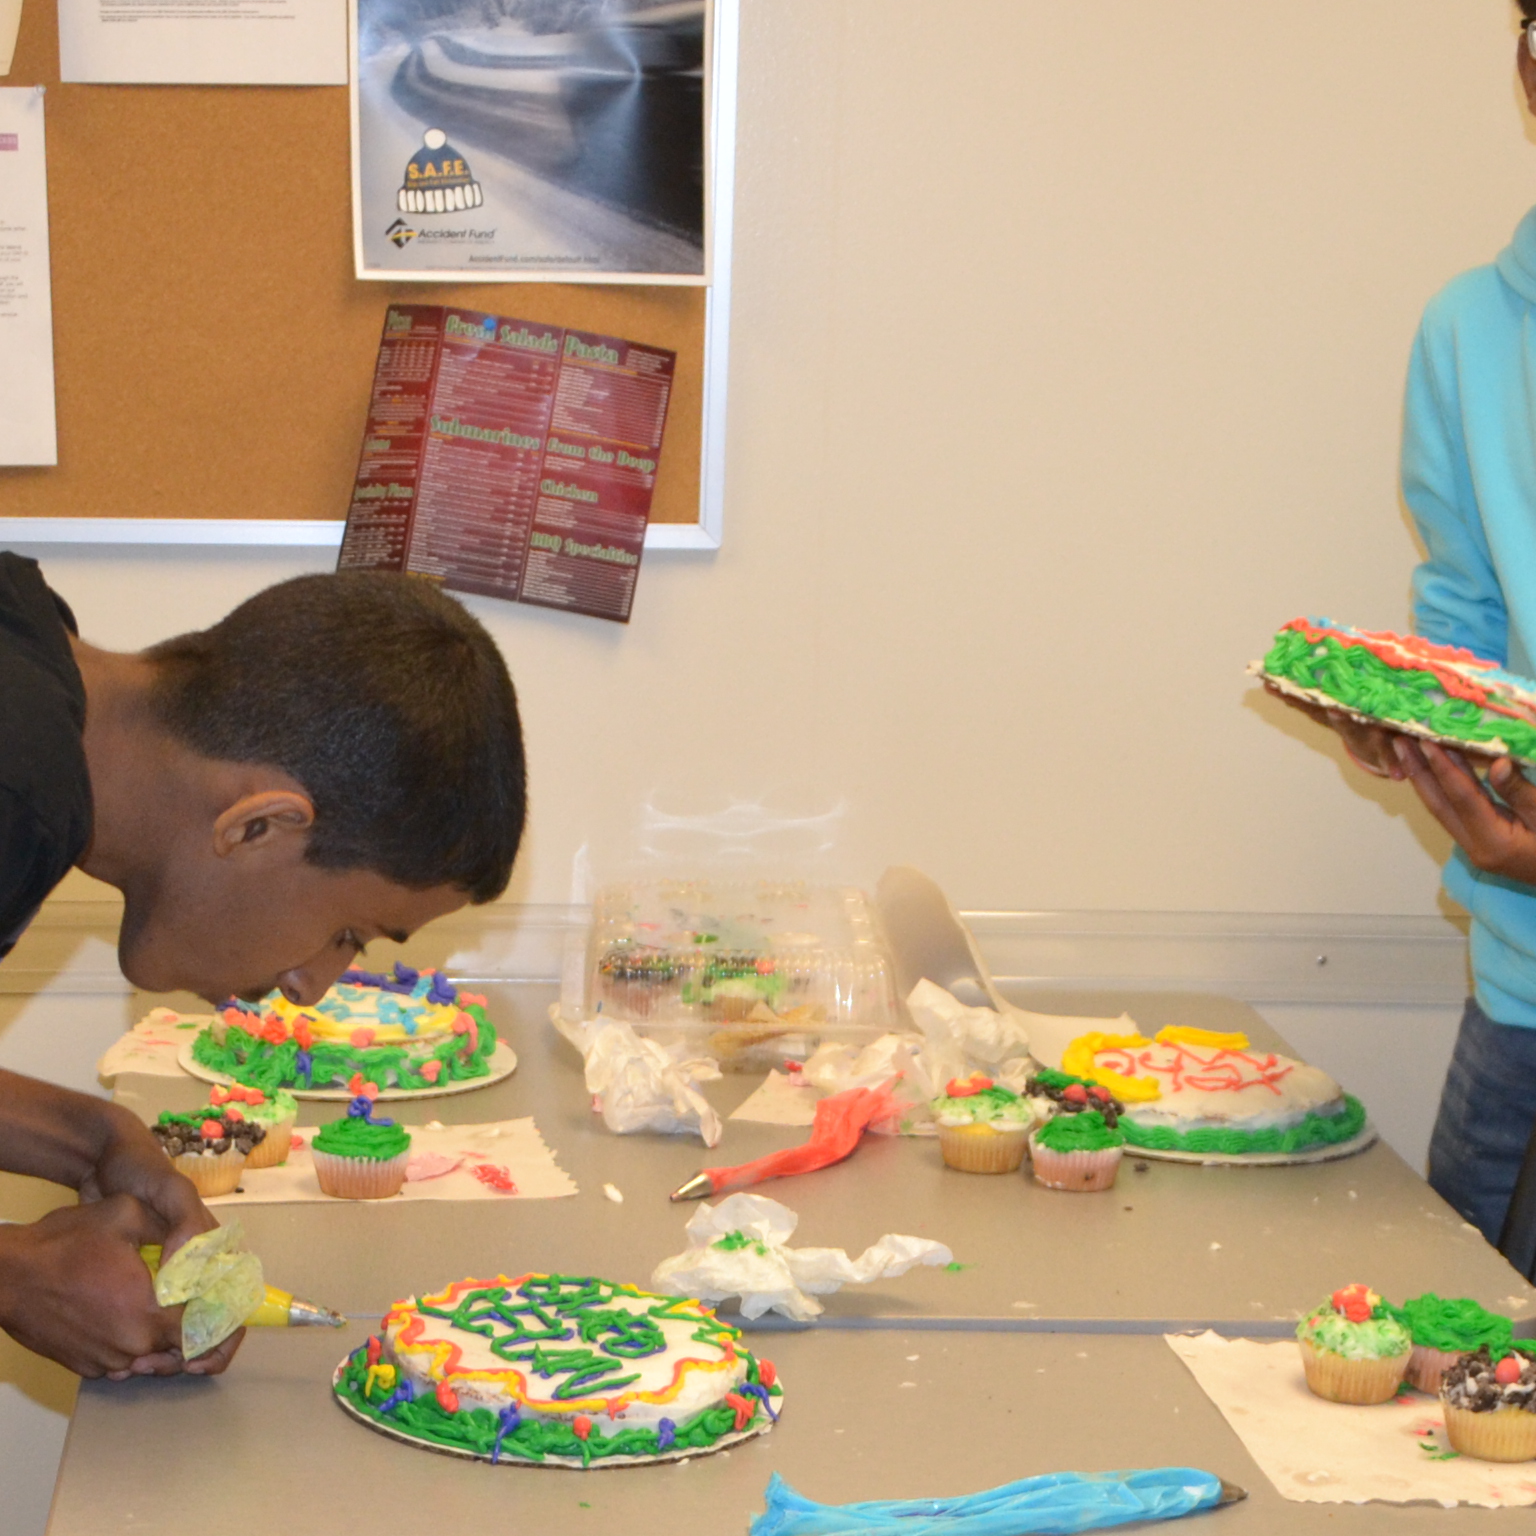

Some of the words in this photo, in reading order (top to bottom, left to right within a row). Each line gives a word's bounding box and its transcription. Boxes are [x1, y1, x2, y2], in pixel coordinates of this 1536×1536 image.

[408, 159, 470, 179] S.A.F.E.
[418, 228, 467, 239] Accident
[469, 228, 495, 239] Fund
[500, 325, 559, 354] Salads
[564, 335, 619, 364] Pasta
[430, 414, 540, 450] Submarines
[547, 437, 585, 458] From
[588, 445, 614, 463] the
[617, 450, 656, 473] Deep
[541, 479, 599, 503] Chicken
[531, 531, 562, 553] BBQ
[565, 537, 639, 565] Specialties
